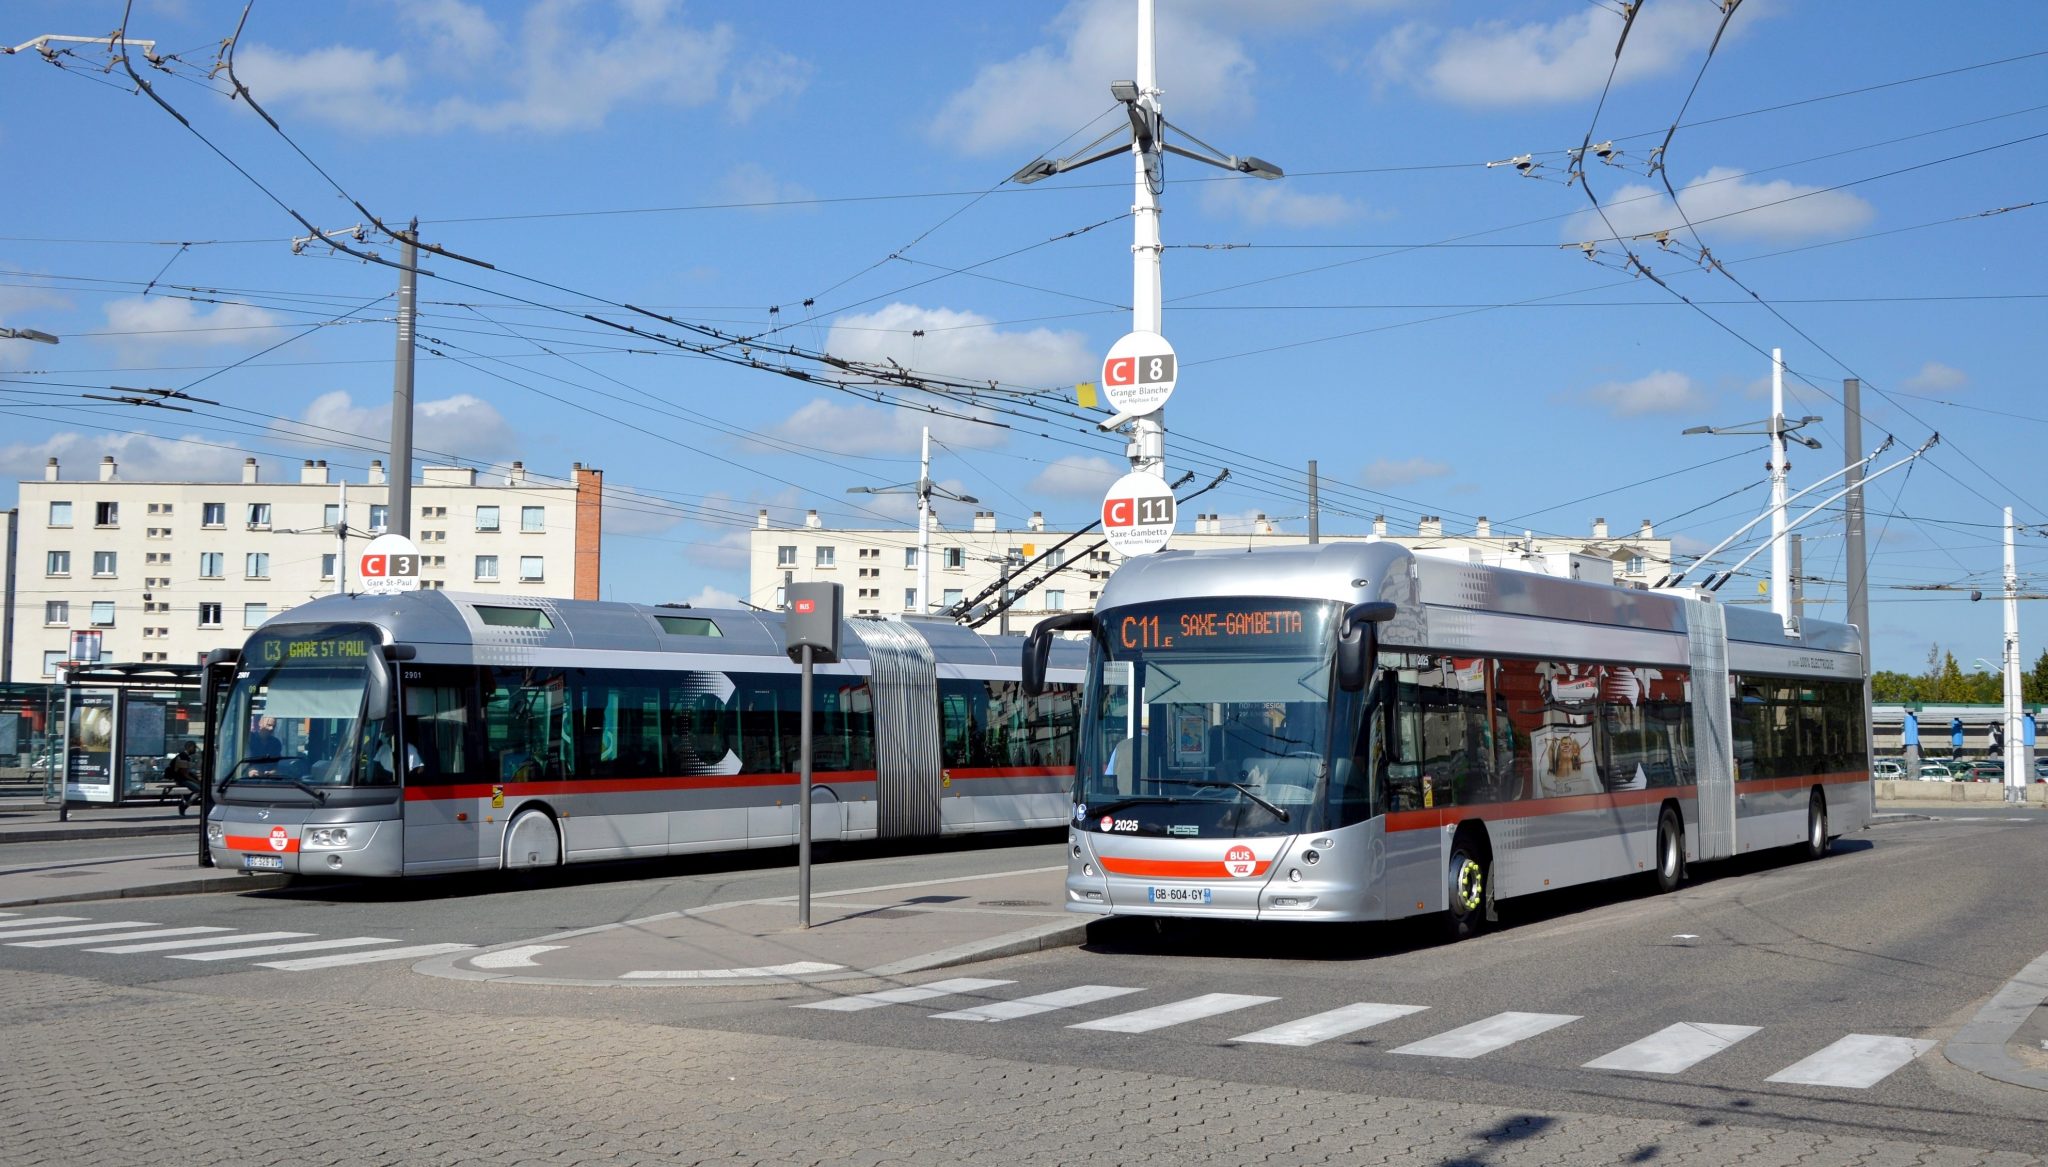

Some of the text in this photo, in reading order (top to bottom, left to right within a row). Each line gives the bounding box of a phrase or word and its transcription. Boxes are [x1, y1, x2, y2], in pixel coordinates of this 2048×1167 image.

[1112, 357, 1163, 382] C 8
[1110, 386, 1169, 398] Grange Blanche
[1111, 499, 1170, 523] C 11
[1110, 528, 1168, 538] Saxe-Gambetta
[367, 556, 410, 575] C 3
[367, 578, 412, 587] Gare St-Paul
[1122, 615, 1159, 649] C11
[1180, 610, 1302, 637] SAXE-GAMBETTA
[264, 640, 368, 661] C3 GARE ST PAUL
[404, 671, 421, 679] 2901
[1114, 819, 1139, 832] 2025
[1166, 824, 1199, 835] HESS
[272, 830, 286, 838] BUS
[1230, 851, 1250, 861] BUS
[1155, 888, 1203, 901] GB-604-GY
